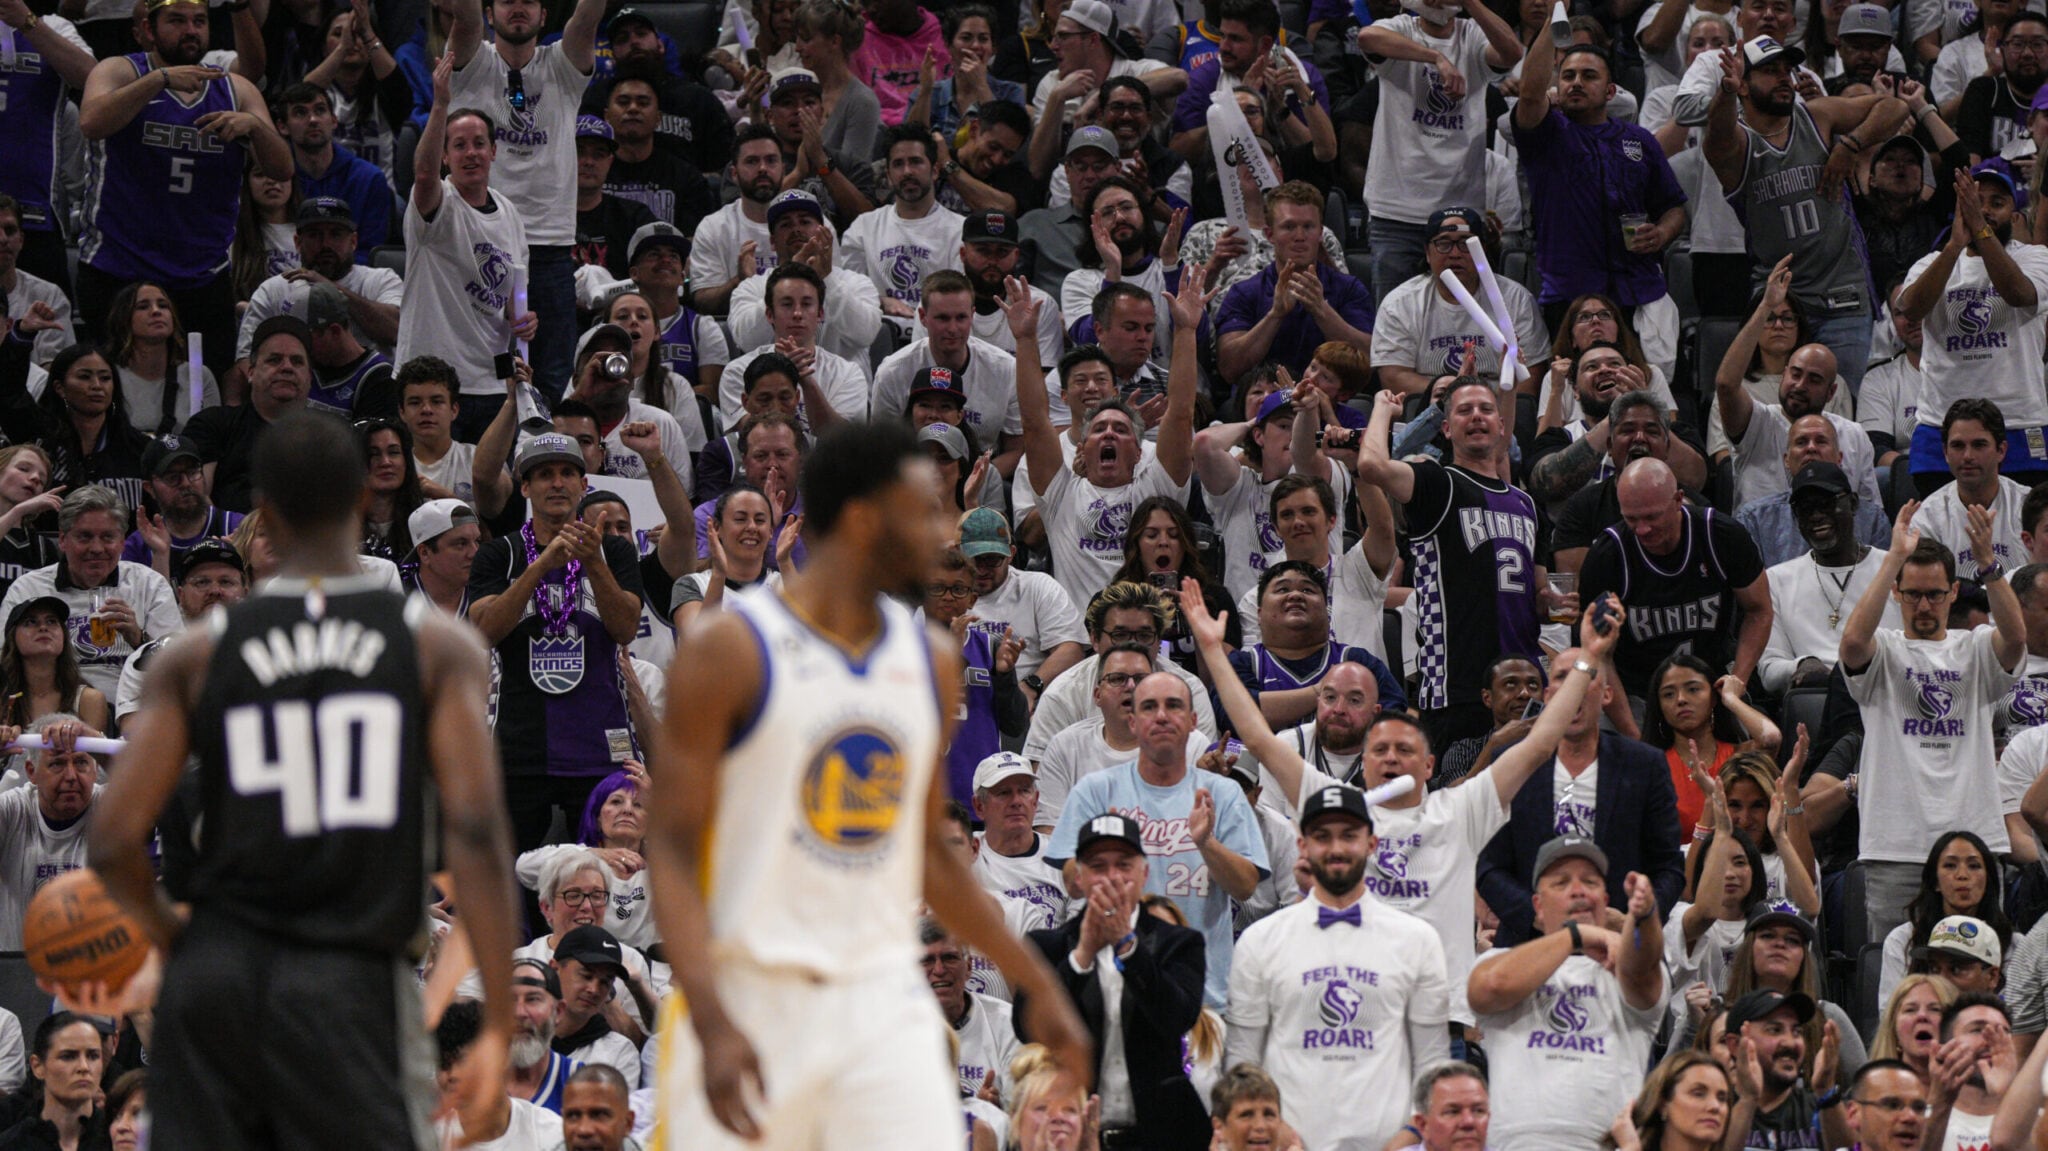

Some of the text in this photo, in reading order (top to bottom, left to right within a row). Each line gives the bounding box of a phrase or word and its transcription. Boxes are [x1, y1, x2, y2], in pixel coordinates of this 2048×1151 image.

[1412, 108, 1464, 130] ROAR!
[142, 121, 224, 153] SAC
[495, 127, 548, 146] ROAR!
[169, 156, 195, 194] 5
[1752, 165, 1827, 205] SACRAMENT
[1780, 198, 1821, 240] 10
[880, 246, 930, 262] FEEL THE
[1429, 335, 1486, 351] FEEL THE
[1947, 332, 2008, 352] ROAR!
[1459, 507, 1537, 562] KINGS
[1496, 547, 1527, 594] 2
[1627, 592, 1722, 642] KINGS
[531, 659, 582, 672] KINGS
[1903, 719, 1965, 737] ROAR!
[225, 691, 401, 838] 40
[1166, 862, 1209, 897] 24
[1366, 877, 1430, 898] ROAR!
[1302, 966, 1379, 987] FEEL THE
[1303, 1029, 1374, 1050] ROAR!
[1527, 1030, 1605, 1055] ROAR!
